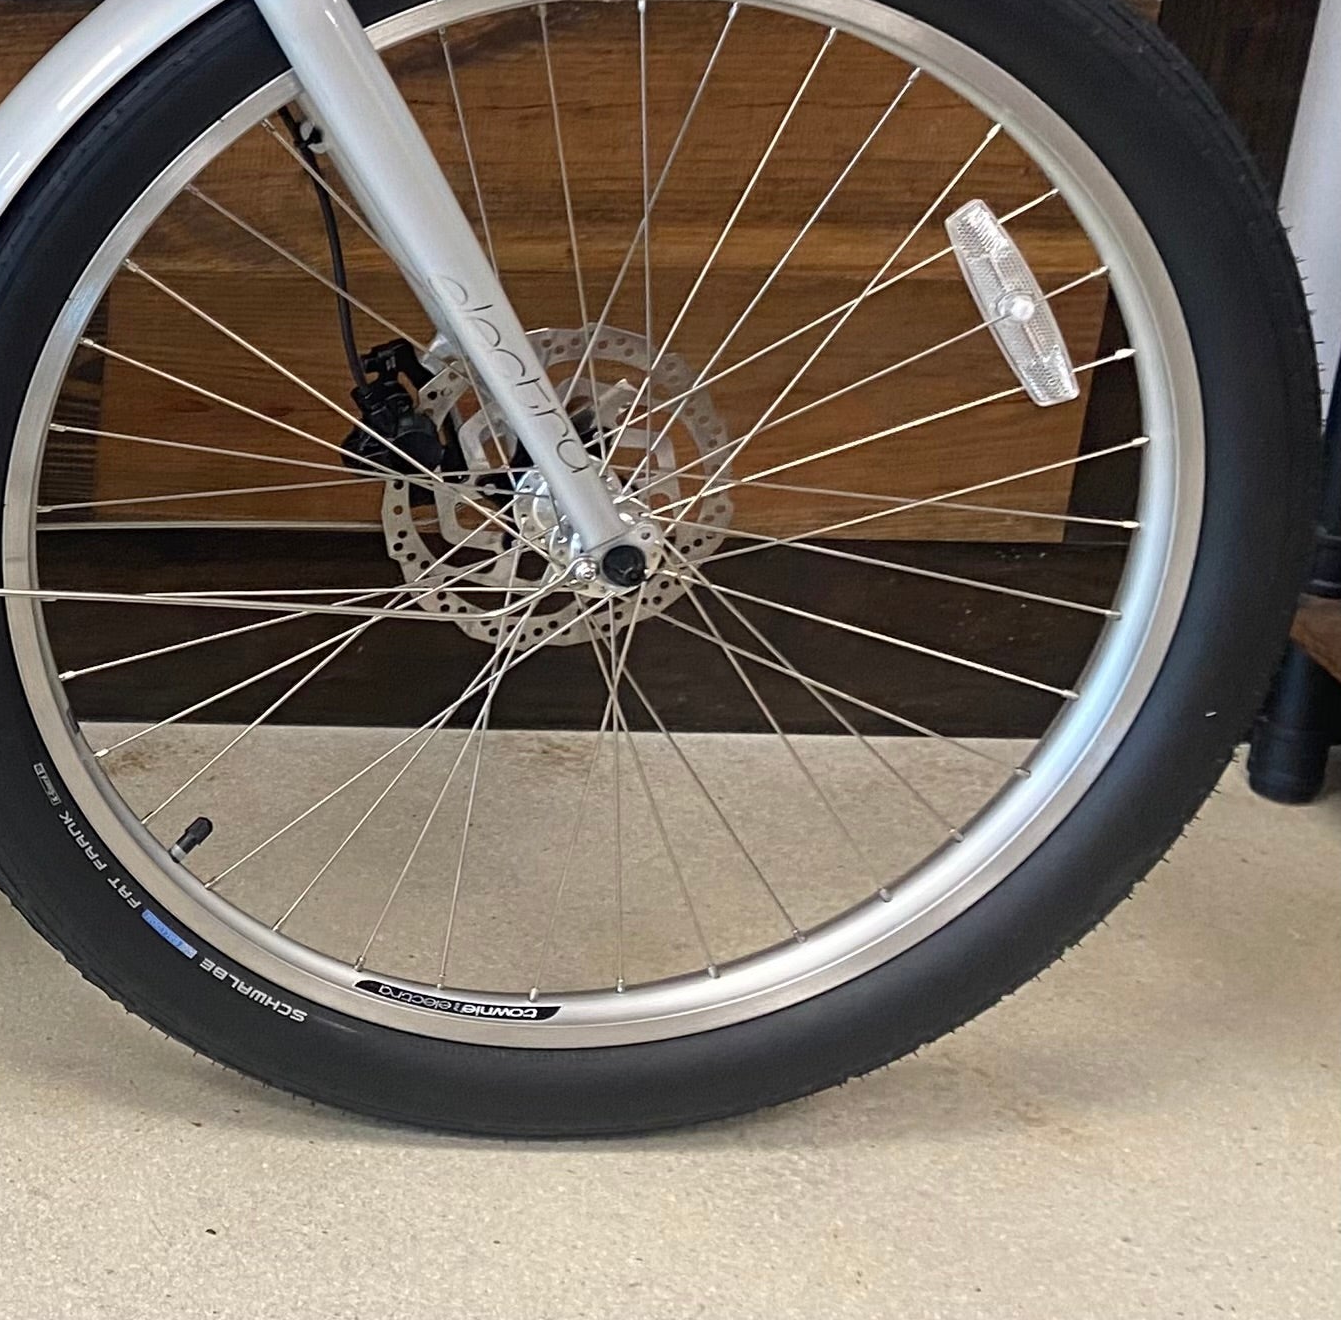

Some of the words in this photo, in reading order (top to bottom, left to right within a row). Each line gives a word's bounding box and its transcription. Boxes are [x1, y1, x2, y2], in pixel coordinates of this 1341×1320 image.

[106, 875, 143, 910] FAT
[200, 956, 309, 1025] SCHWALBE
[377, 983, 453, 1015] electra
[459, 1002, 539, 1021] townie
